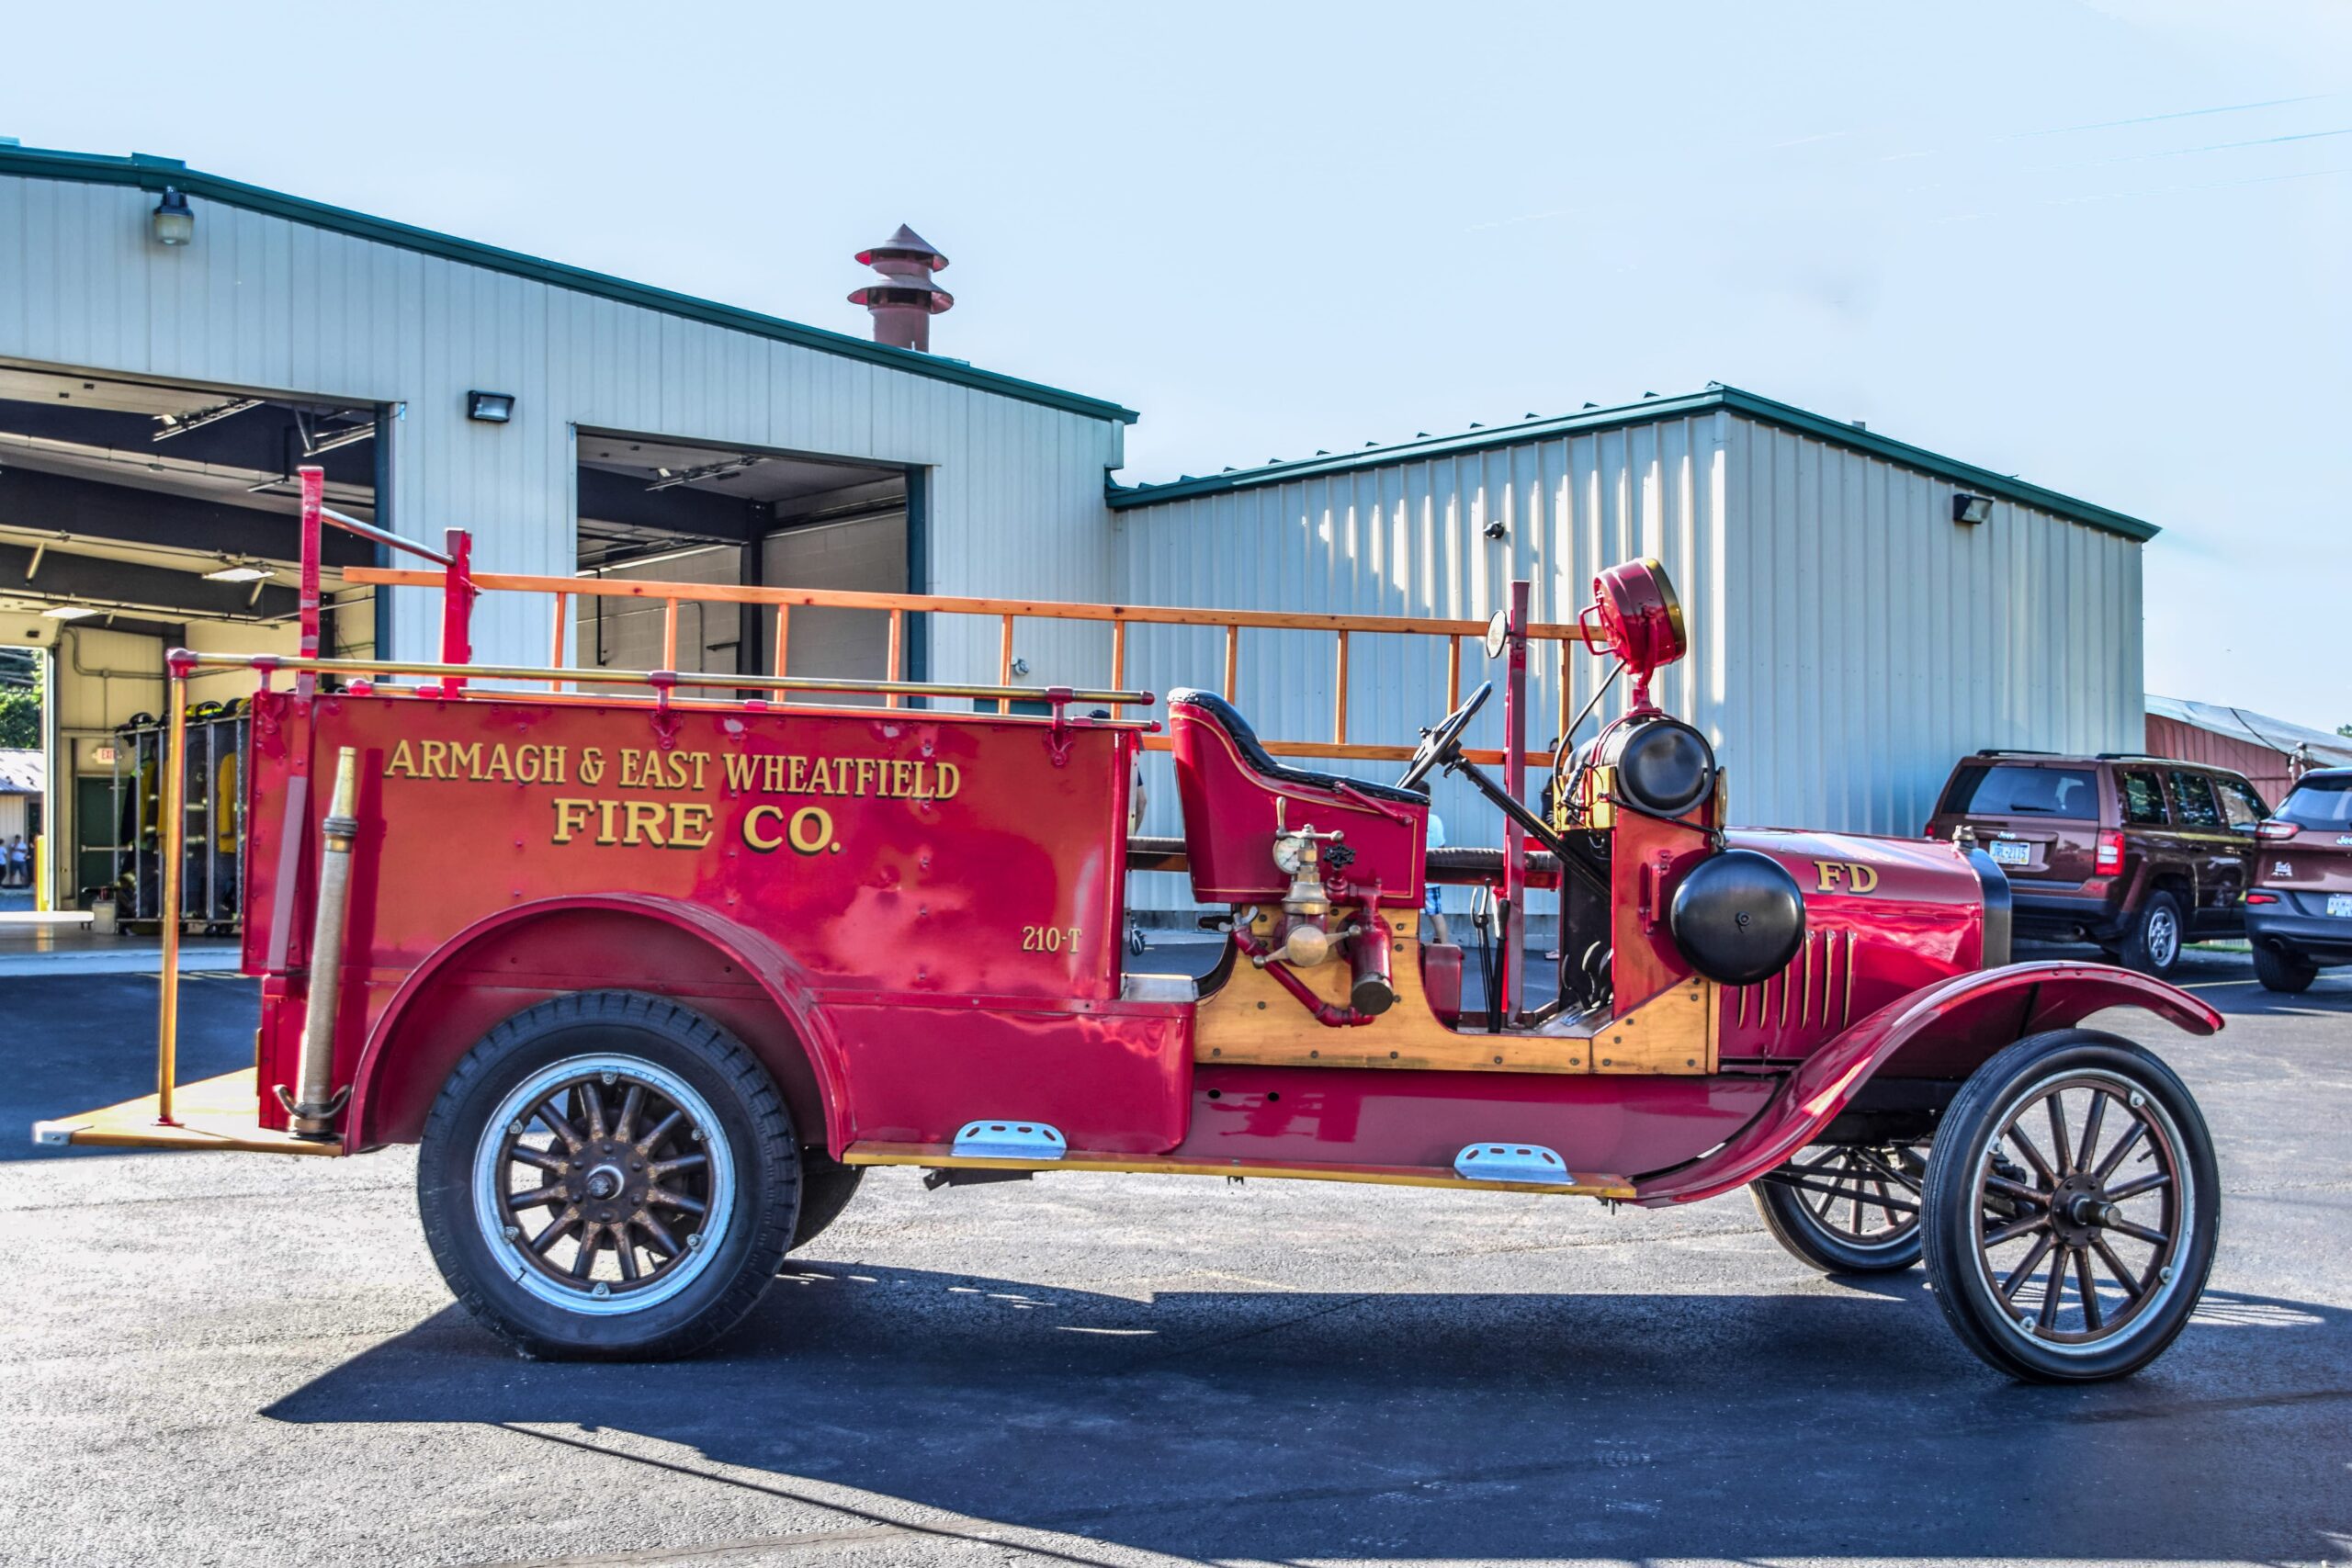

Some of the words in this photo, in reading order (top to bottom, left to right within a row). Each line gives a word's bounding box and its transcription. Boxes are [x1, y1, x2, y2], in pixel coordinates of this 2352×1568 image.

[383, 739, 568, 783] ARMAGH
[578, 747, 606, 785] &
[618, 748, 710, 790] EAST
[722, 752, 961, 800] WHEATFIELD
[552, 797, 714, 849] FIRE
[741, 804, 842, 855] CO.
[1812, 860, 1879, 894] FD
[1021, 925, 1083, 954] 210-T
